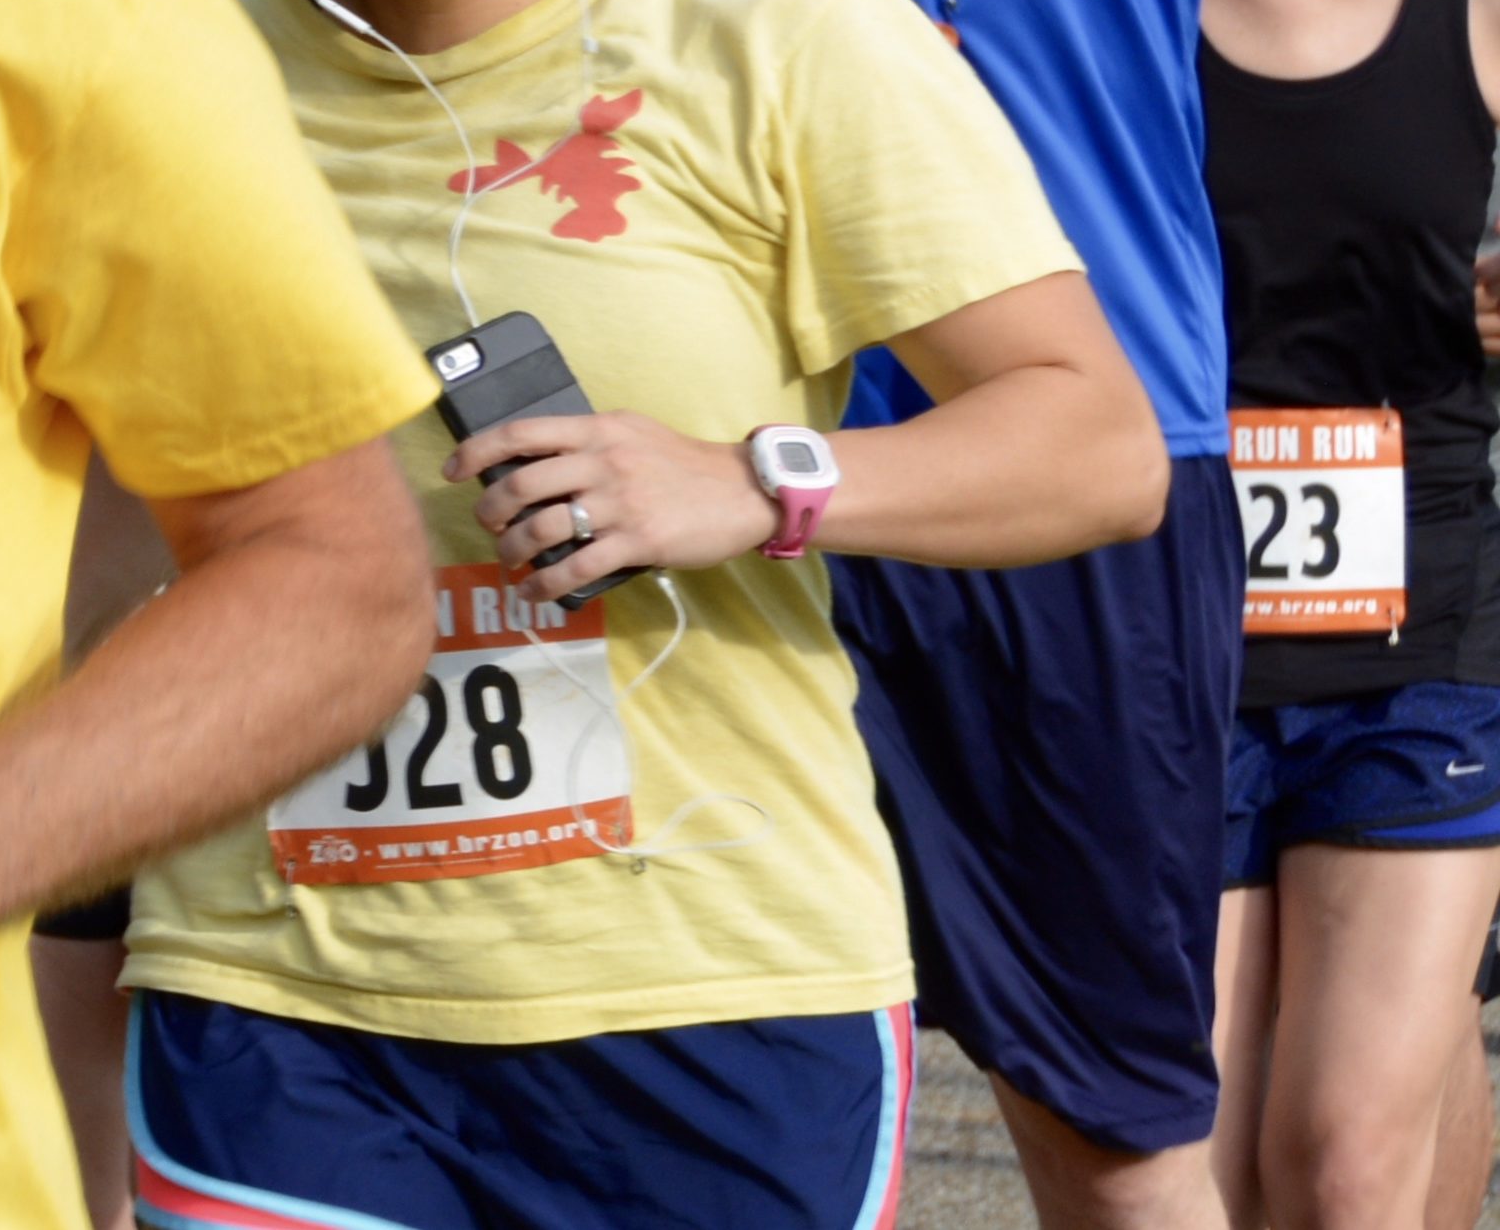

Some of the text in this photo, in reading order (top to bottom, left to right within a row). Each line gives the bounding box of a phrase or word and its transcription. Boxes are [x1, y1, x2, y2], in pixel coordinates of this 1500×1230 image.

[1234, 423, 1377, 463] RUN RUN
[1247, 481, 1342, 581] 23
[378, 817, 599, 860] www.brzoo.org
